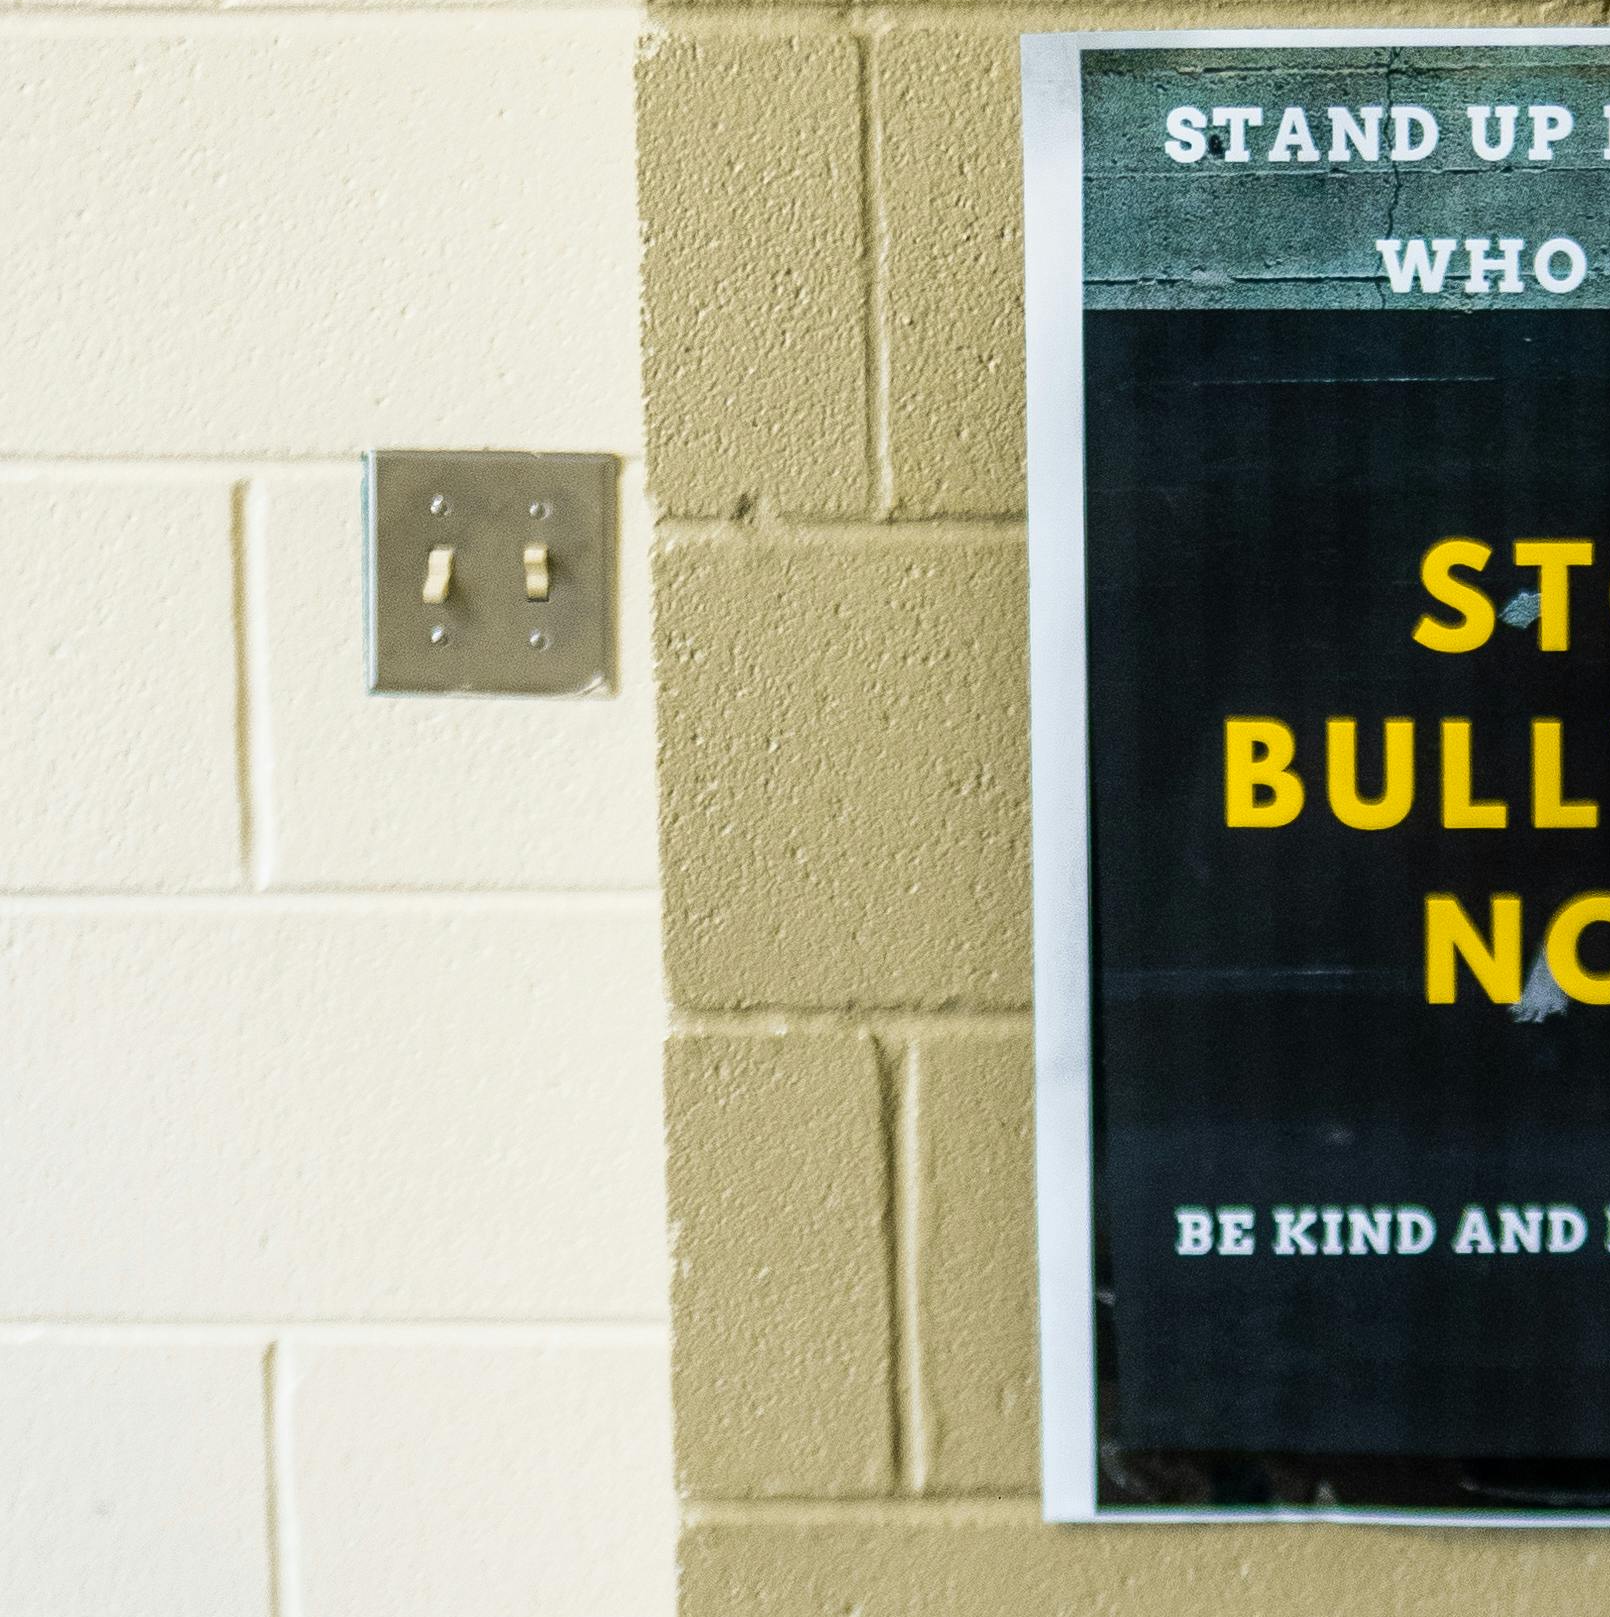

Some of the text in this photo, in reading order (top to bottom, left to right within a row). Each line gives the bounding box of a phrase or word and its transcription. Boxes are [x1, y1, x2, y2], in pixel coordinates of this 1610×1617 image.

[1164, 105, 1441, 166] STAND
[1466, 104, 1576, 164] UP
[1375, 237, 1589, 296] WHO
[1177, 1210, 1256, 1257] BE
[1274, 1209, 1436, 1257] KIND
[1454, 1208, 1588, 1256] AND
